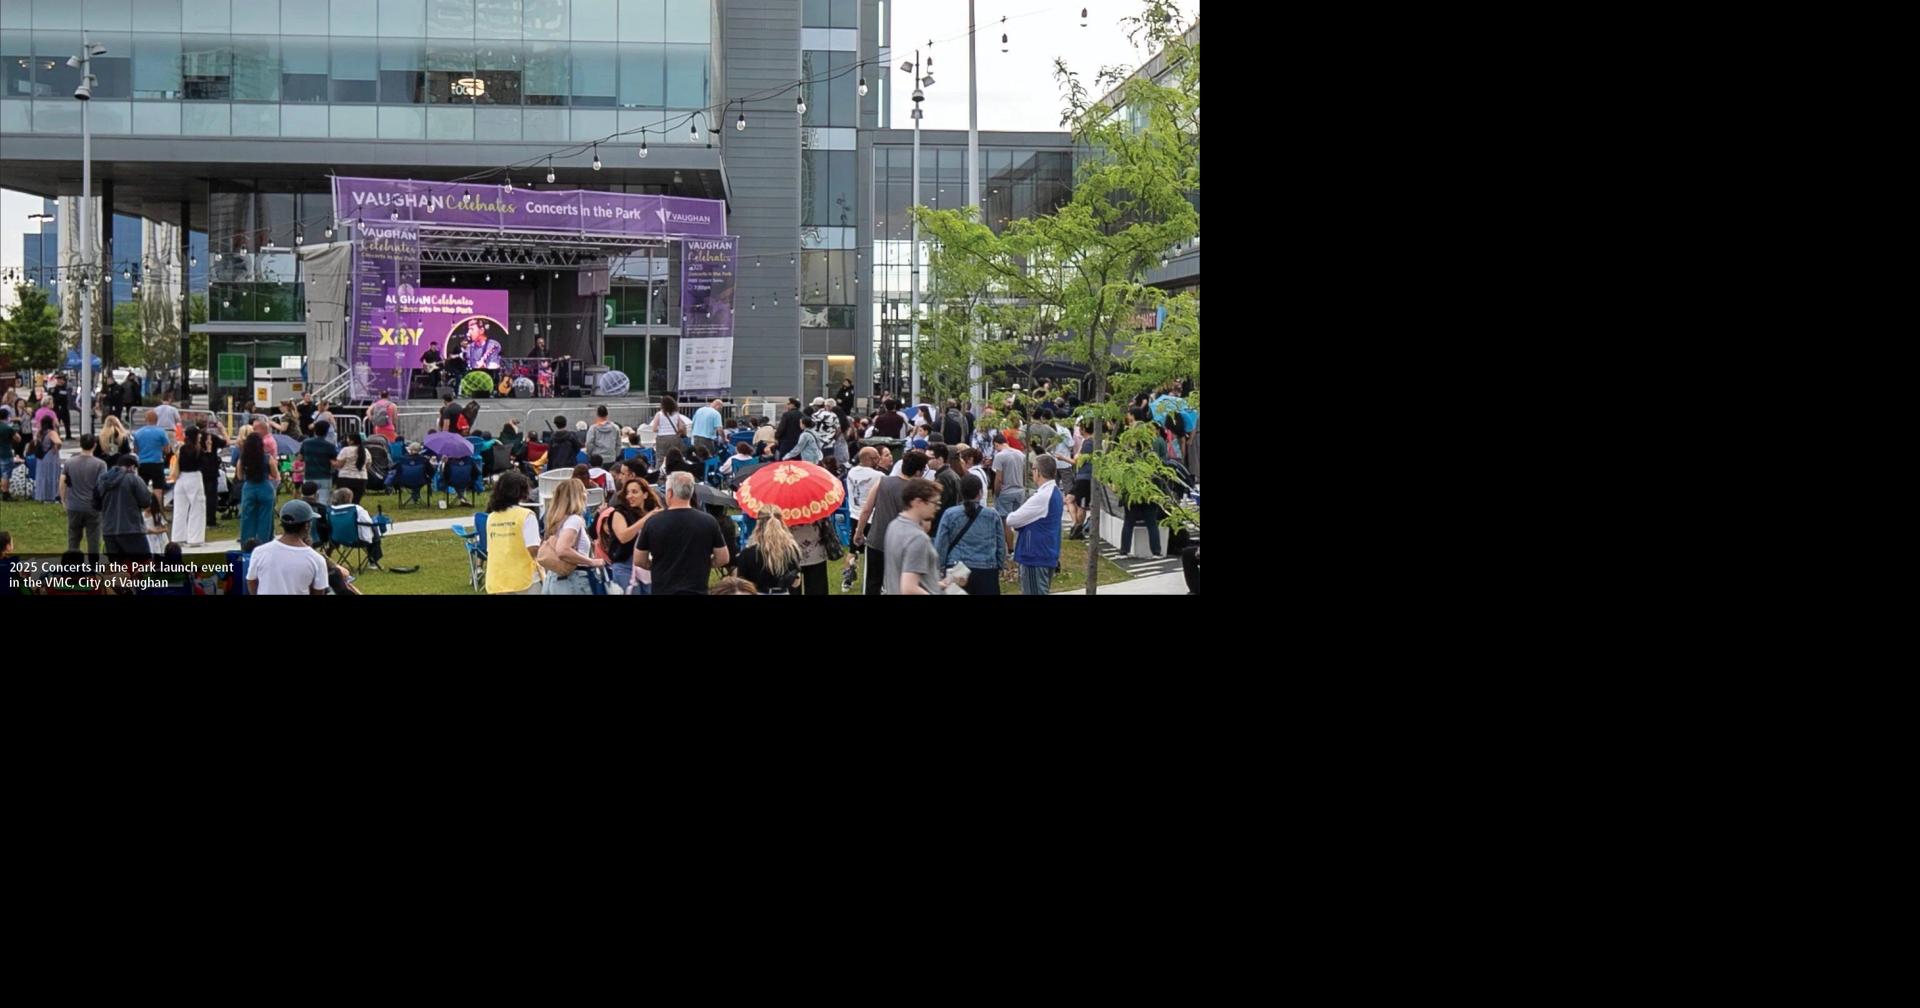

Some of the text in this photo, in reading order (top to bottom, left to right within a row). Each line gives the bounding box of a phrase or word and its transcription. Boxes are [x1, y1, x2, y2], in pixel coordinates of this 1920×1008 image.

[352, 191, 641, 220] VAUGHAN Celebrates Concerts in the Park
[672, 213, 711, 223] VAUGHAN
[361, 227, 417, 241] VAUGHAN
[360, 237, 417, 254] Celebrates
[688, 241, 733, 250] VAUGHAN
[687, 249, 732, 263] Celebrates
[384, 293, 473, 306] AUGHAN Celebrates
[442, 306, 455, 314] the
